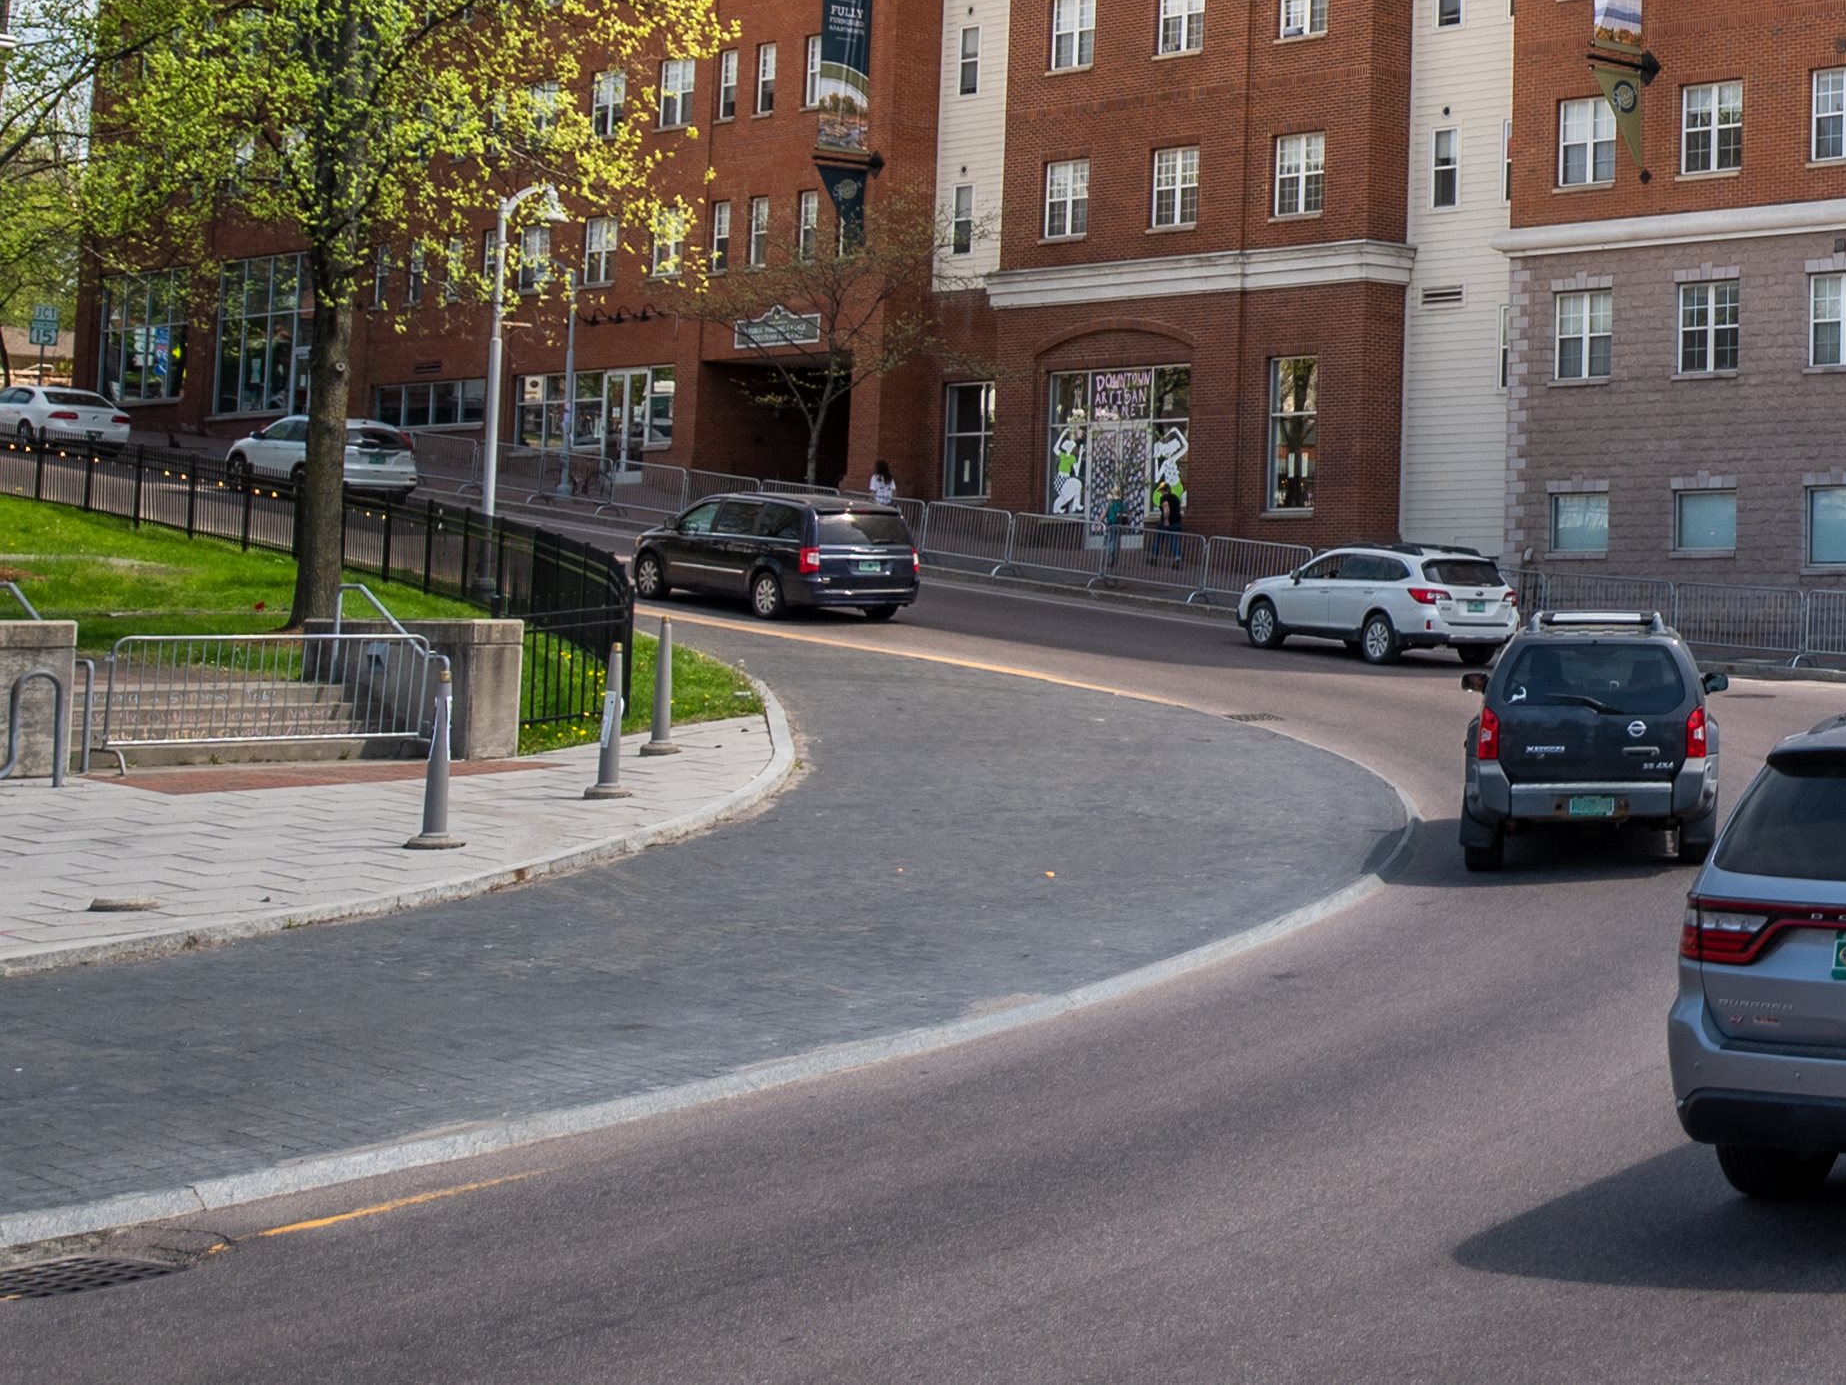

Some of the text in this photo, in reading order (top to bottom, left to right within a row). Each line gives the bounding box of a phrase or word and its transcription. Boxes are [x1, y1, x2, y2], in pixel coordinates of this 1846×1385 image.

[831, 4, 864, 19] FULLY
[35, 307, 55, 319] JCT
[36, 329, 53, 343] 15
[1095, 370, 1152, 392] DOWNTOWN
[1094, 386, 1148, 405] ARTISAN
